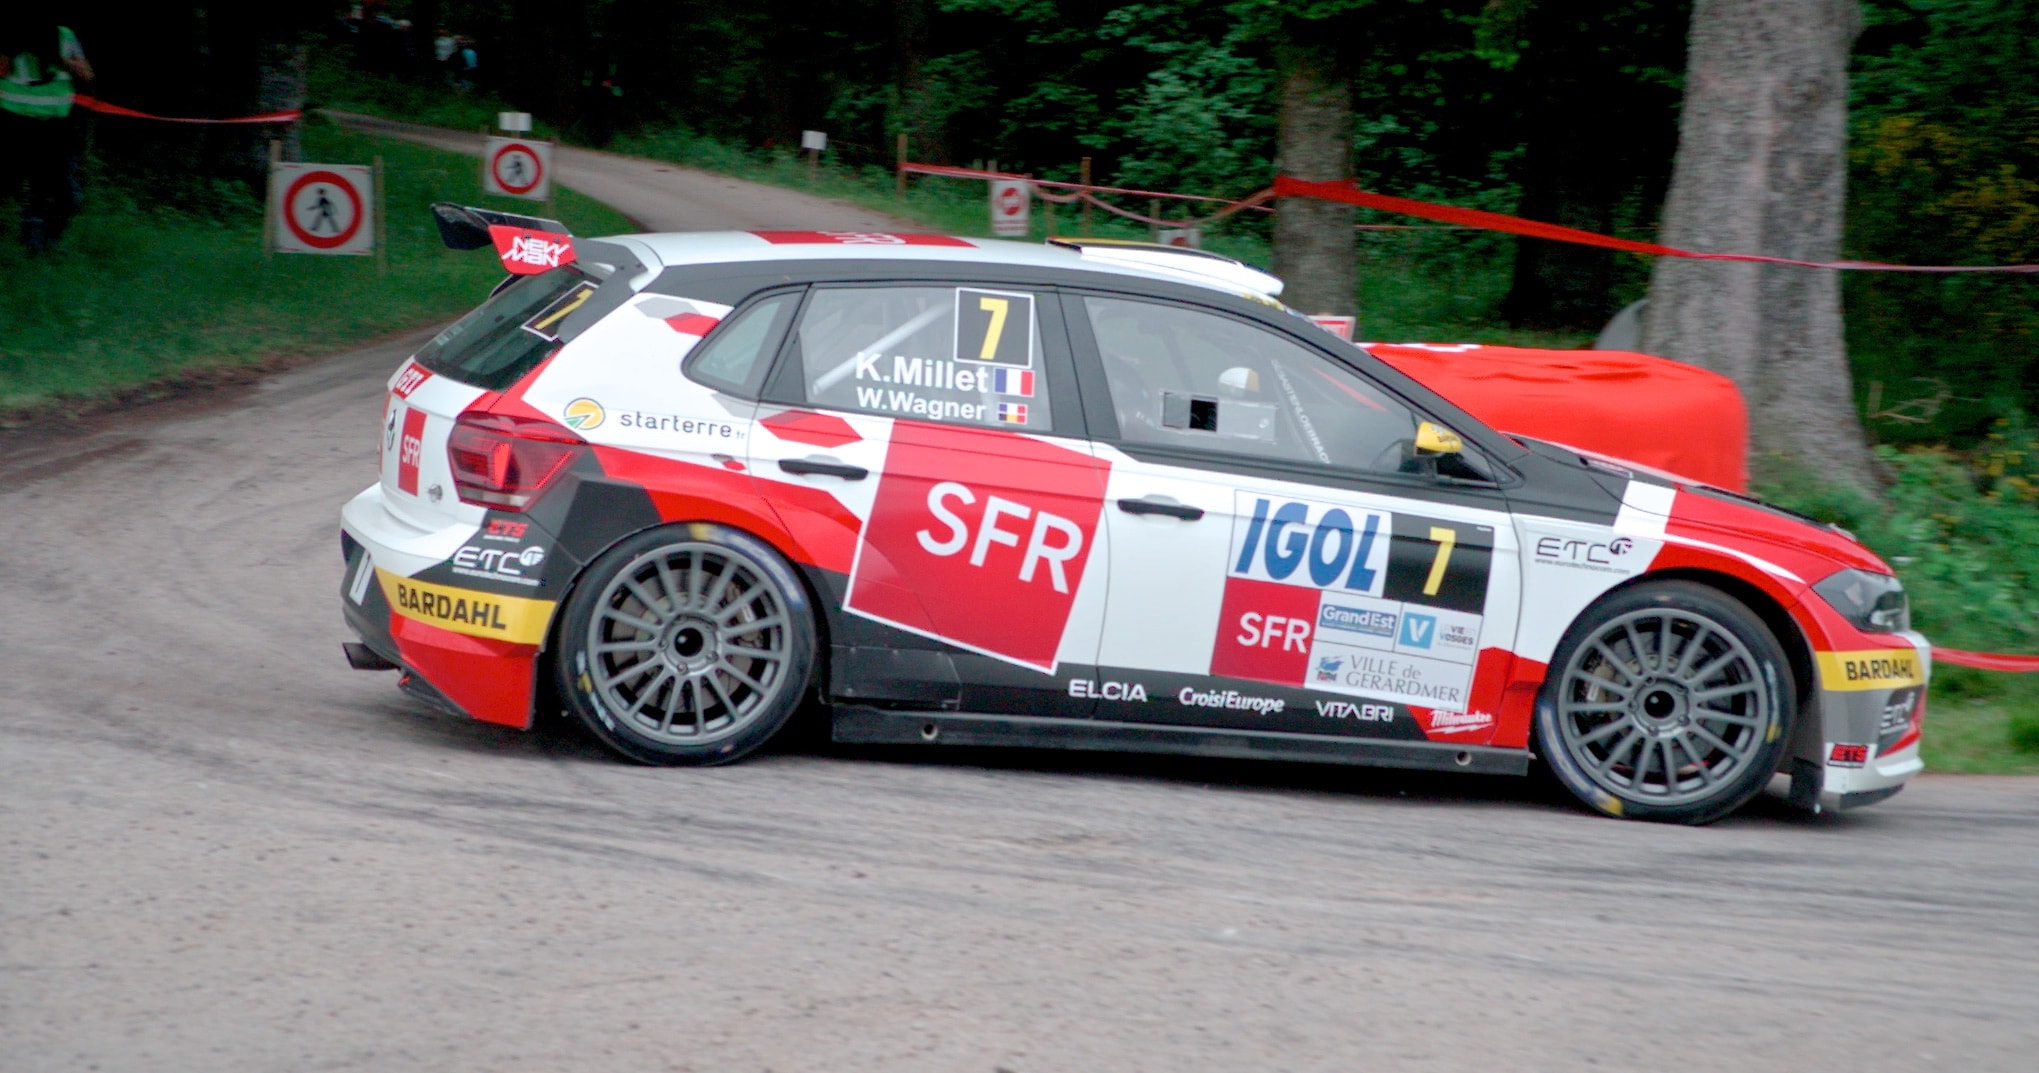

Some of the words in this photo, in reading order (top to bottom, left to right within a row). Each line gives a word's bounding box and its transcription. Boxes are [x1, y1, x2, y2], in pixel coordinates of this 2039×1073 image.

[512, 236, 570, 256] NEW
[980, 297, 1008, 360] 7
[855, 351, 989, 393] K.Millet
[856, 386, 987, 421] W.Wagner
[402, 434, 421, 468] SFR
[916, 481, 1083, 595] SFR
[1235, 498, 1380, 592] IGOL
[1536, 536, 1610, 564] ETC
[453, 545, 522, 576] ETC
[1422, 526, 1456, 596] 7
[397, 583, 506, 630] BARDAHL
[1236, 611, 1311, 653] SFR
[1350, 654, 1398, 676] VILLE
[1402, 664, 1421, 680] de
[1845, 659, 1914, 681] BARDAHL
[1068, 678, 1148, 703] ELCIA
[1179, 687, 1285, 716] CroisiEurope
[1346, 672, 1460, 702] GERARDMER
[1315, 700, 1394, 723] VITABRI
